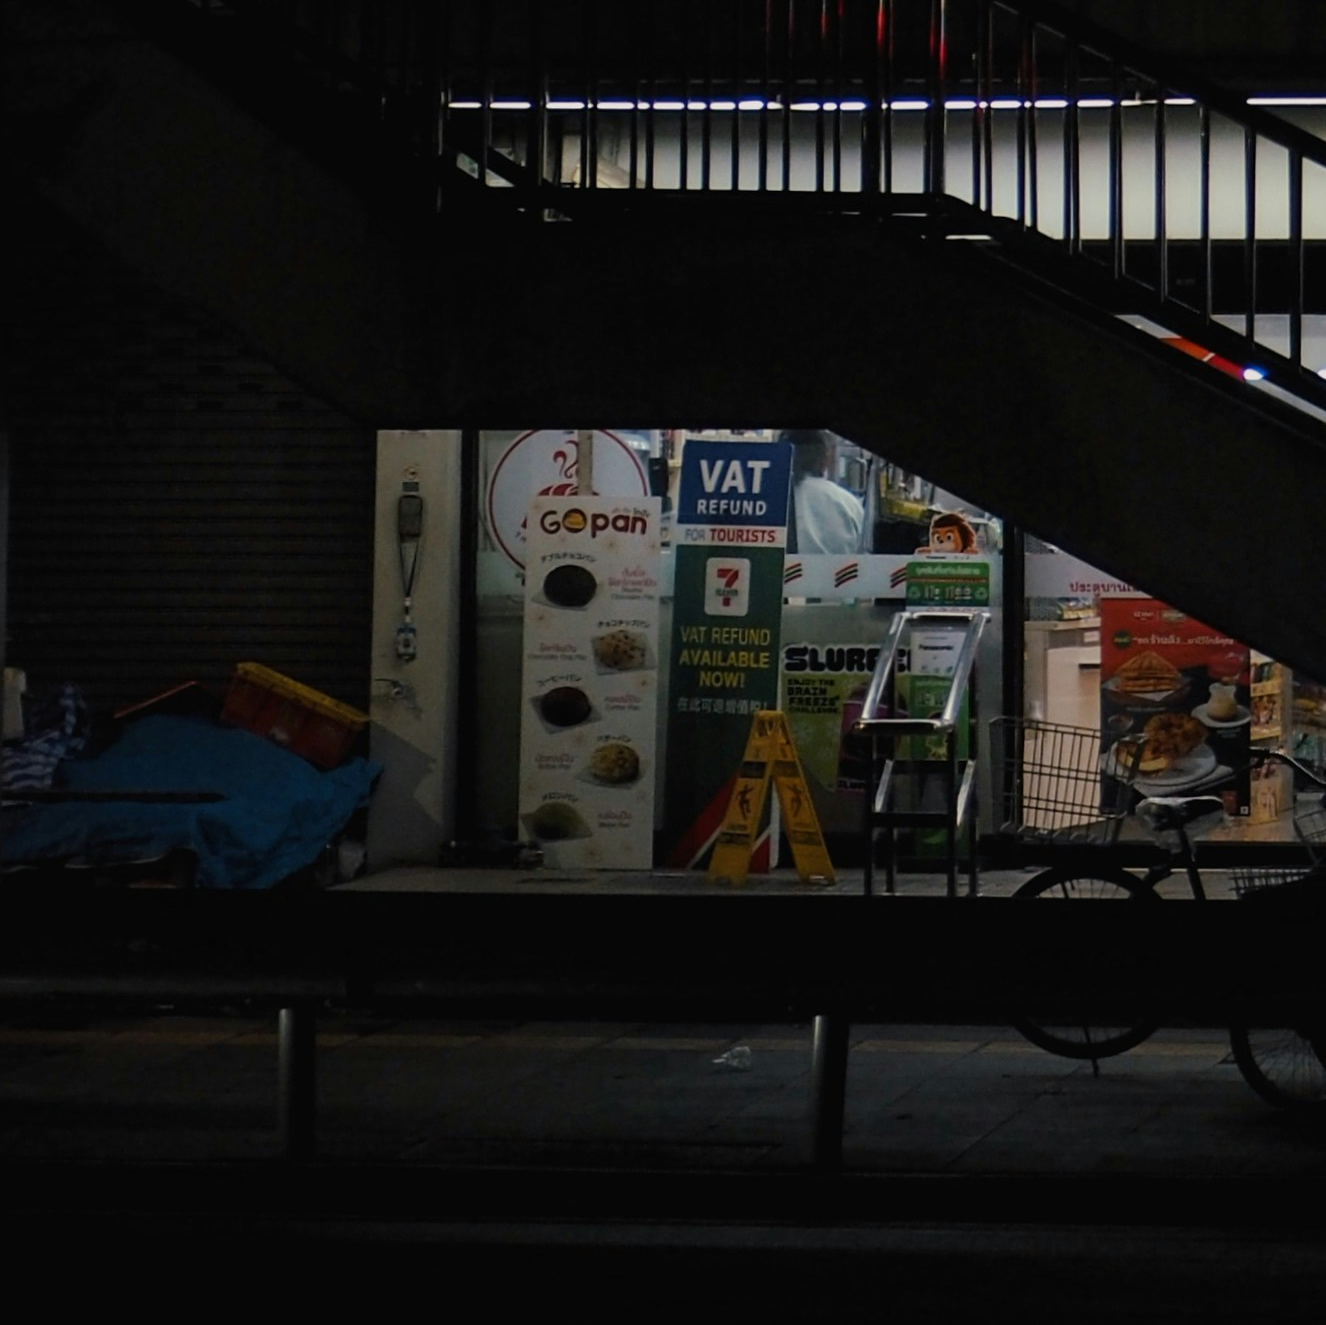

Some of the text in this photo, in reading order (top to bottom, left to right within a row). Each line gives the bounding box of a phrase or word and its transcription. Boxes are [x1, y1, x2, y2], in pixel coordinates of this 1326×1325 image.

[699, 459, 771, 494] VAT
[696, 499, 767, 516] REFUND
[685, 529, 776, 543] FOR TOURISTS
[680, 626, 771, 646] VAT REFUND
[679, 650, 771, 668] AVAILABLE
[698, 671, 746, 688] NOW!
[787, 687, 827, 695] BRAIN
[788, 697, 836, 706] FREEZE
